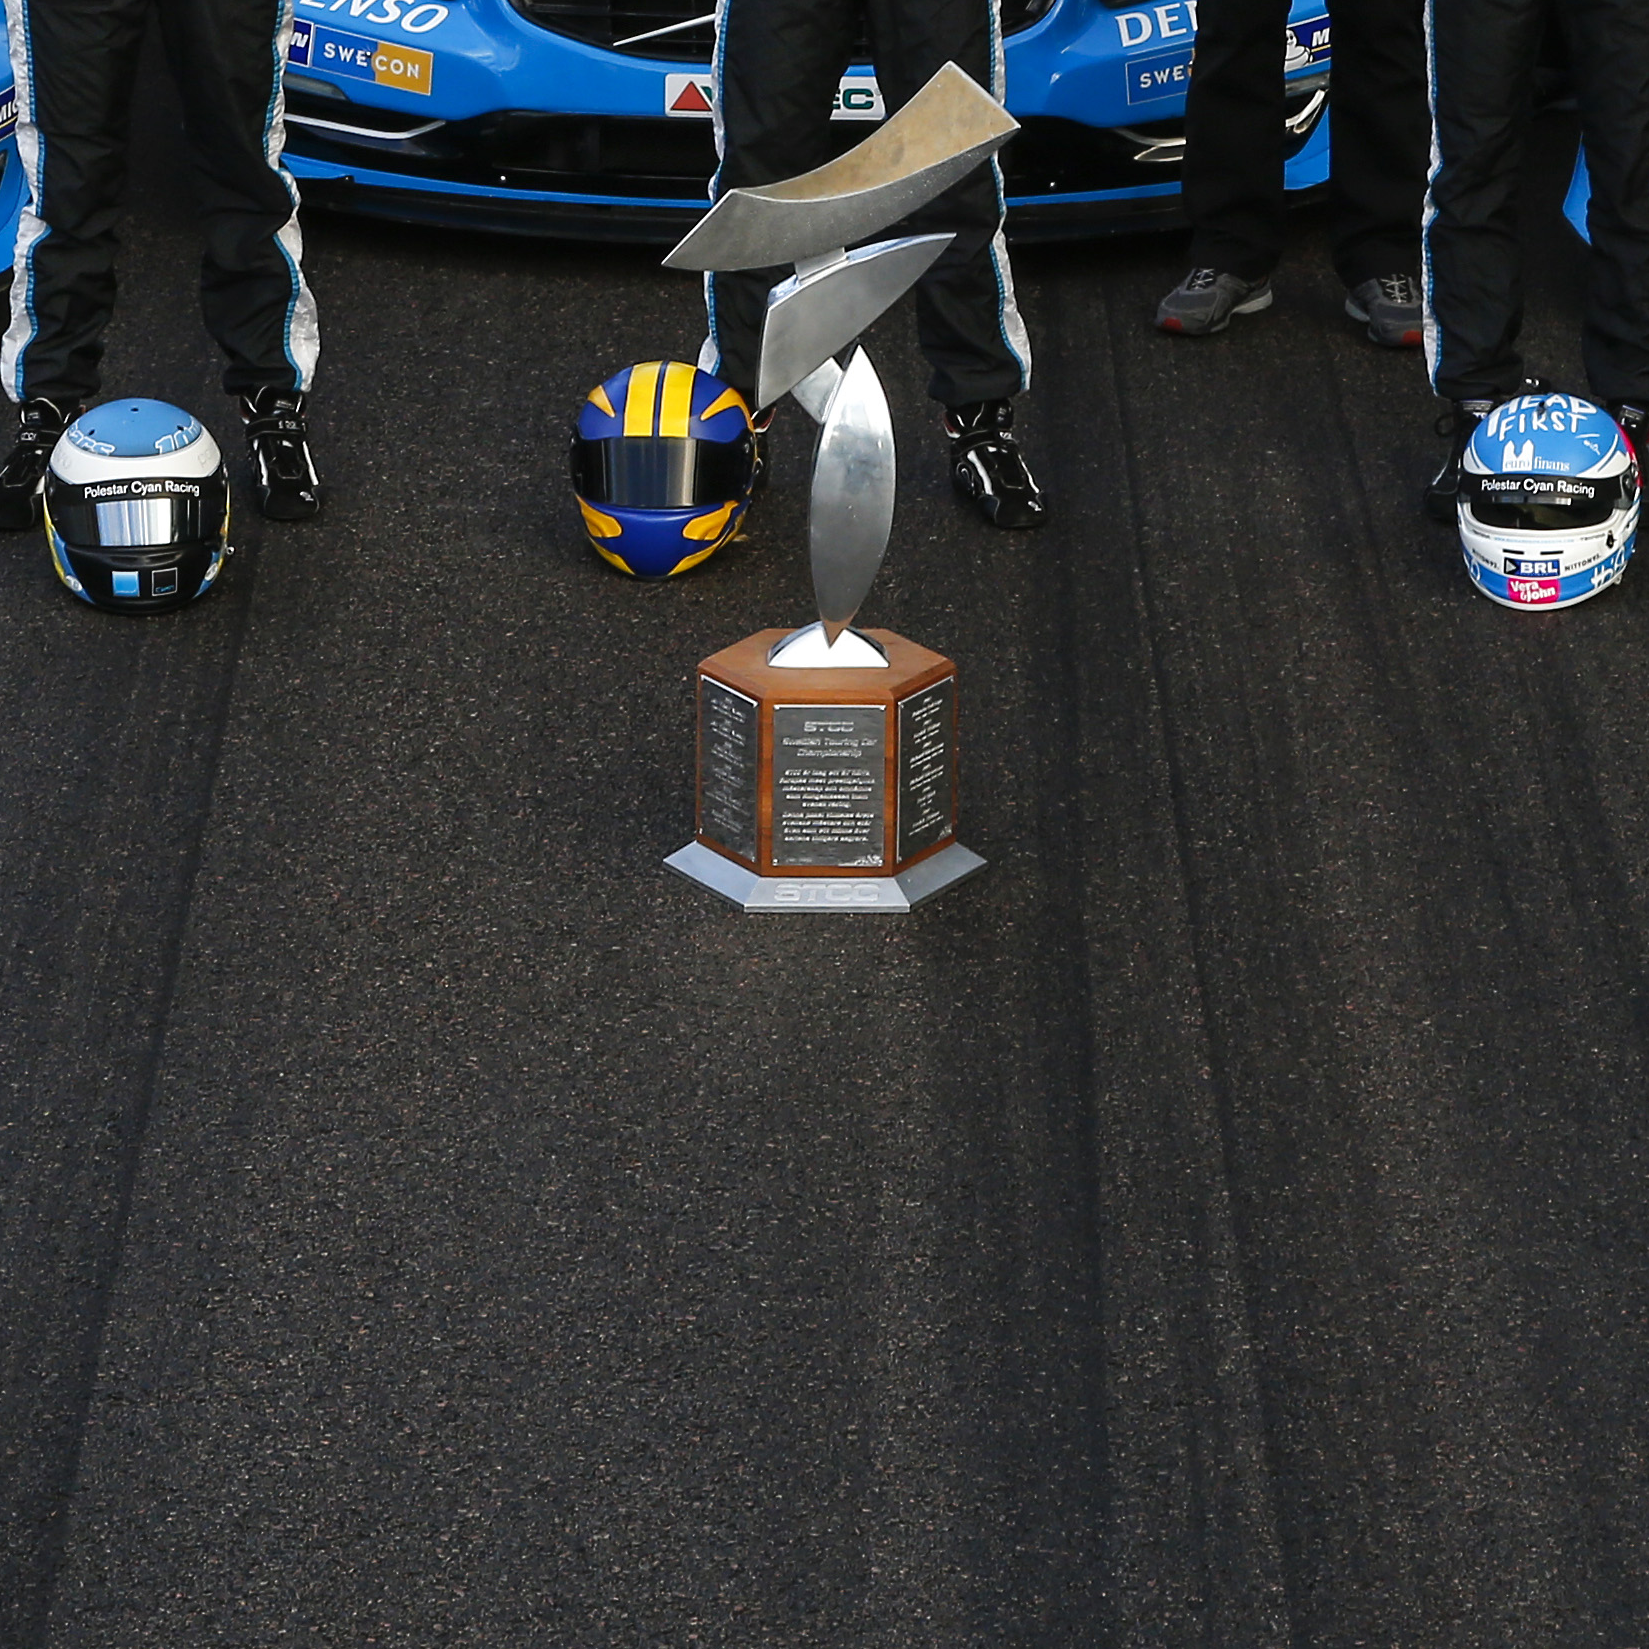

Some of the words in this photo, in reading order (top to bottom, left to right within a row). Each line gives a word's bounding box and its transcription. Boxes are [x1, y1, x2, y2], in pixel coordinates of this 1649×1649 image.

[1499, 411, 1588, 442] FIRST
[1534, 456, 1571, 472] finans
[83, 483, 129, 499] Polestar
[131, 480, 162, 496] Cyan
[164, 480, 200, 497] Racing
[1481, 479, 1521, 491] Polestar
[1523, 479, 1554, 494] Cyan
[1557, 480, 1595, 498] Racing
[1520, 561, 1559, 574] BRL
[1510, 580, 1540, 593] Vera
[773, 882, 881, 904] STCC
